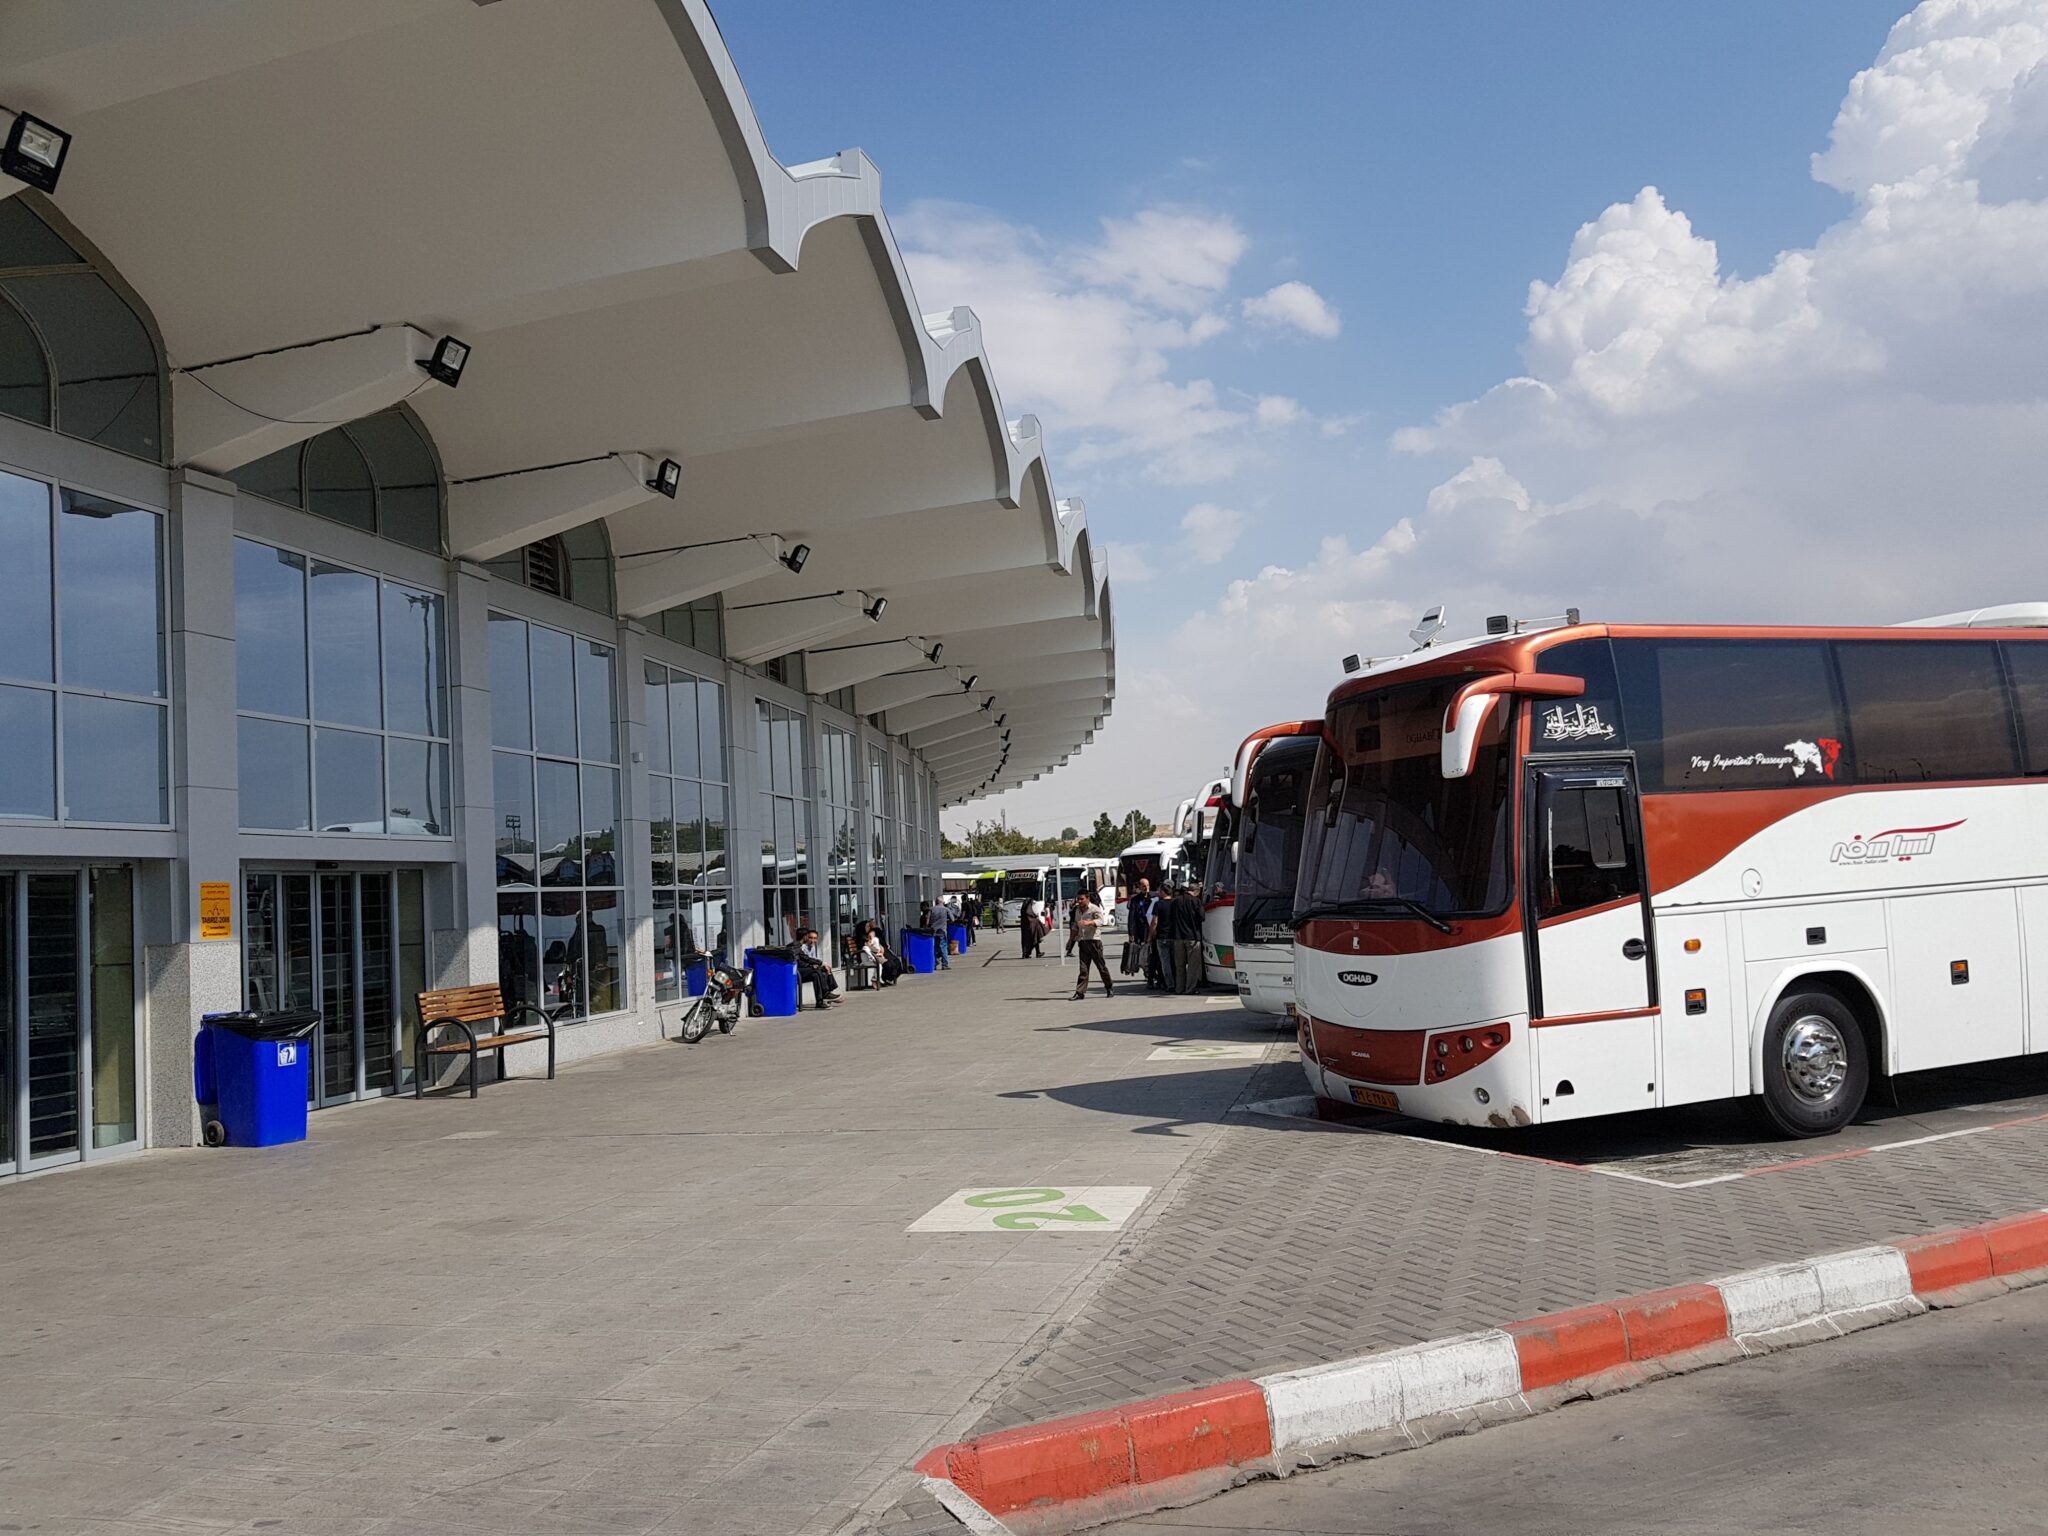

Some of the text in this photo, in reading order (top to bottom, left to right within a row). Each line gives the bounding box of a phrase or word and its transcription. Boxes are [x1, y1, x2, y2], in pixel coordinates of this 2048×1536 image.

[1690, 753, 1794, 772] Very Important Passenger
[1342, 973, 1373, 984] OGHAB
[964, 1188, 1111, 1230] 20
